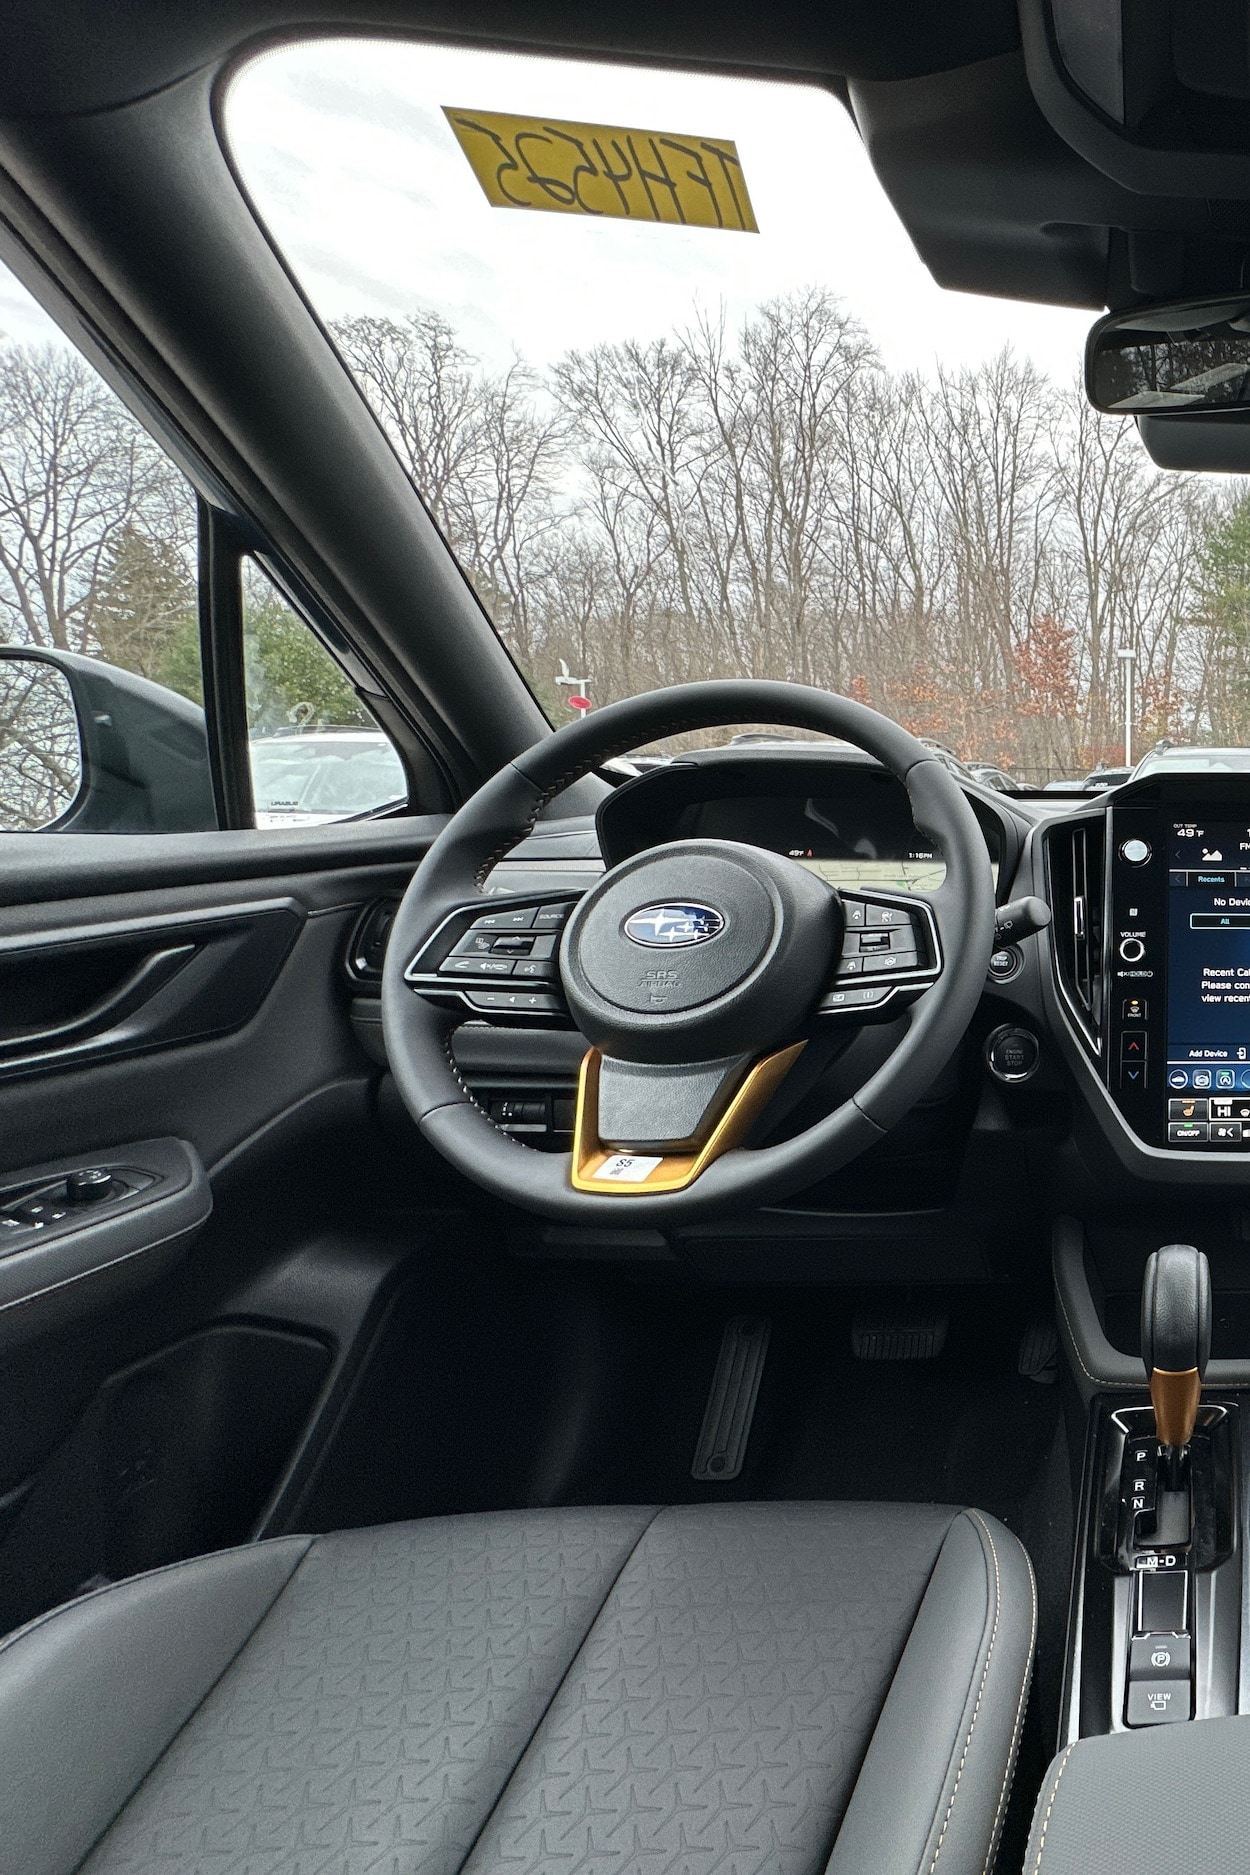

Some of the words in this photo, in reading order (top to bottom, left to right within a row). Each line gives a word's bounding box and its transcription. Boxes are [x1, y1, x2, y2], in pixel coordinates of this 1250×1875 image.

[1214, 898, 1226, 906] No
[646, 970, 679, 979] SRS
[1203, 968, 1234, 977] Recent
[1201, 981, 1232, 990] Please
[1201, 993, 1221, 1003] view
[1189, 1049, 1204, 1058] Add
[1206, 1049, 1228, 1058] Device
[1217, 1105, 1231, 1117] HI
[1177, 1129, 1200, 1137] ON/OFF
[616, 1158, 636, 1168] S5
[1136, 1452, 1146, 1461] P
[1134, 1481, 1145, 1491] R
[1133, 1499, 1144, 1509] N
[1147, 1693, 1171, 1701] VIEW
